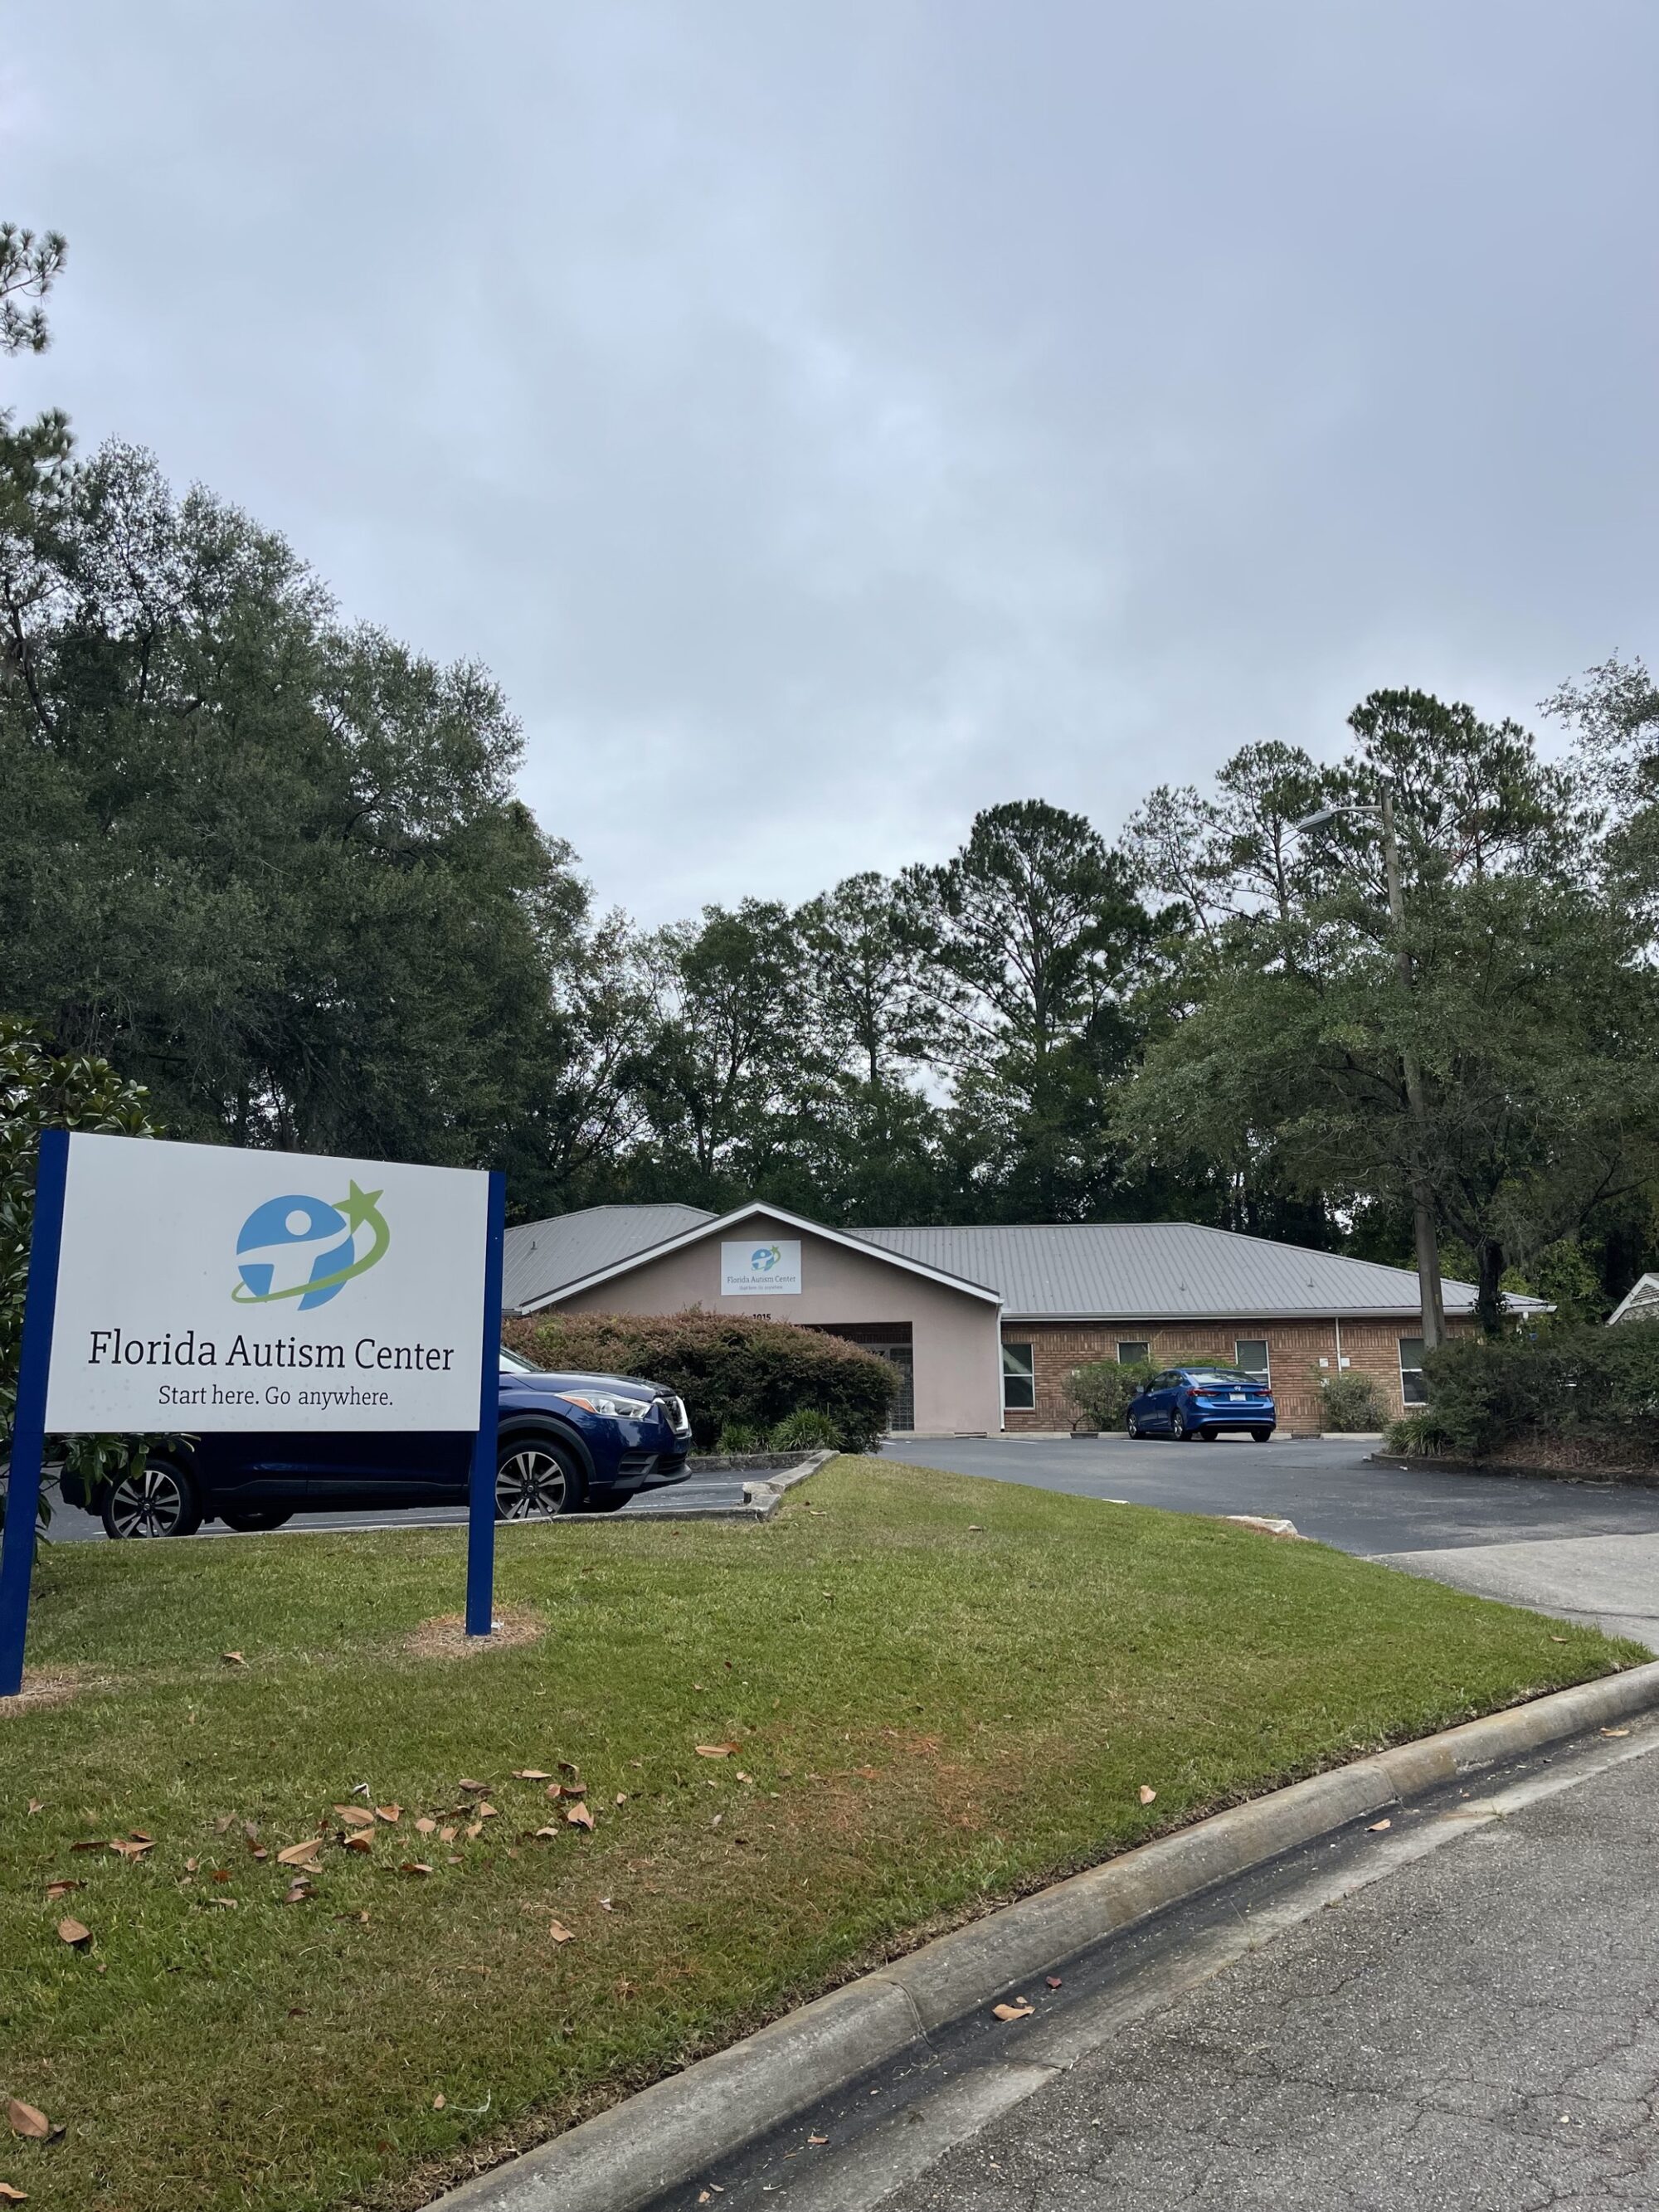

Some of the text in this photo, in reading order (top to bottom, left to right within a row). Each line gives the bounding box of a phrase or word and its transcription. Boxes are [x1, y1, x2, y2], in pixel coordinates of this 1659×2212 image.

[727, 1276, 750, 1284] Florida
[775, 1275, 796, 1283] Center
[88, 1328, 455, 1371] Florida Autism Center
[158, 1383, 393, 1411] Start here. Go anywhere.
